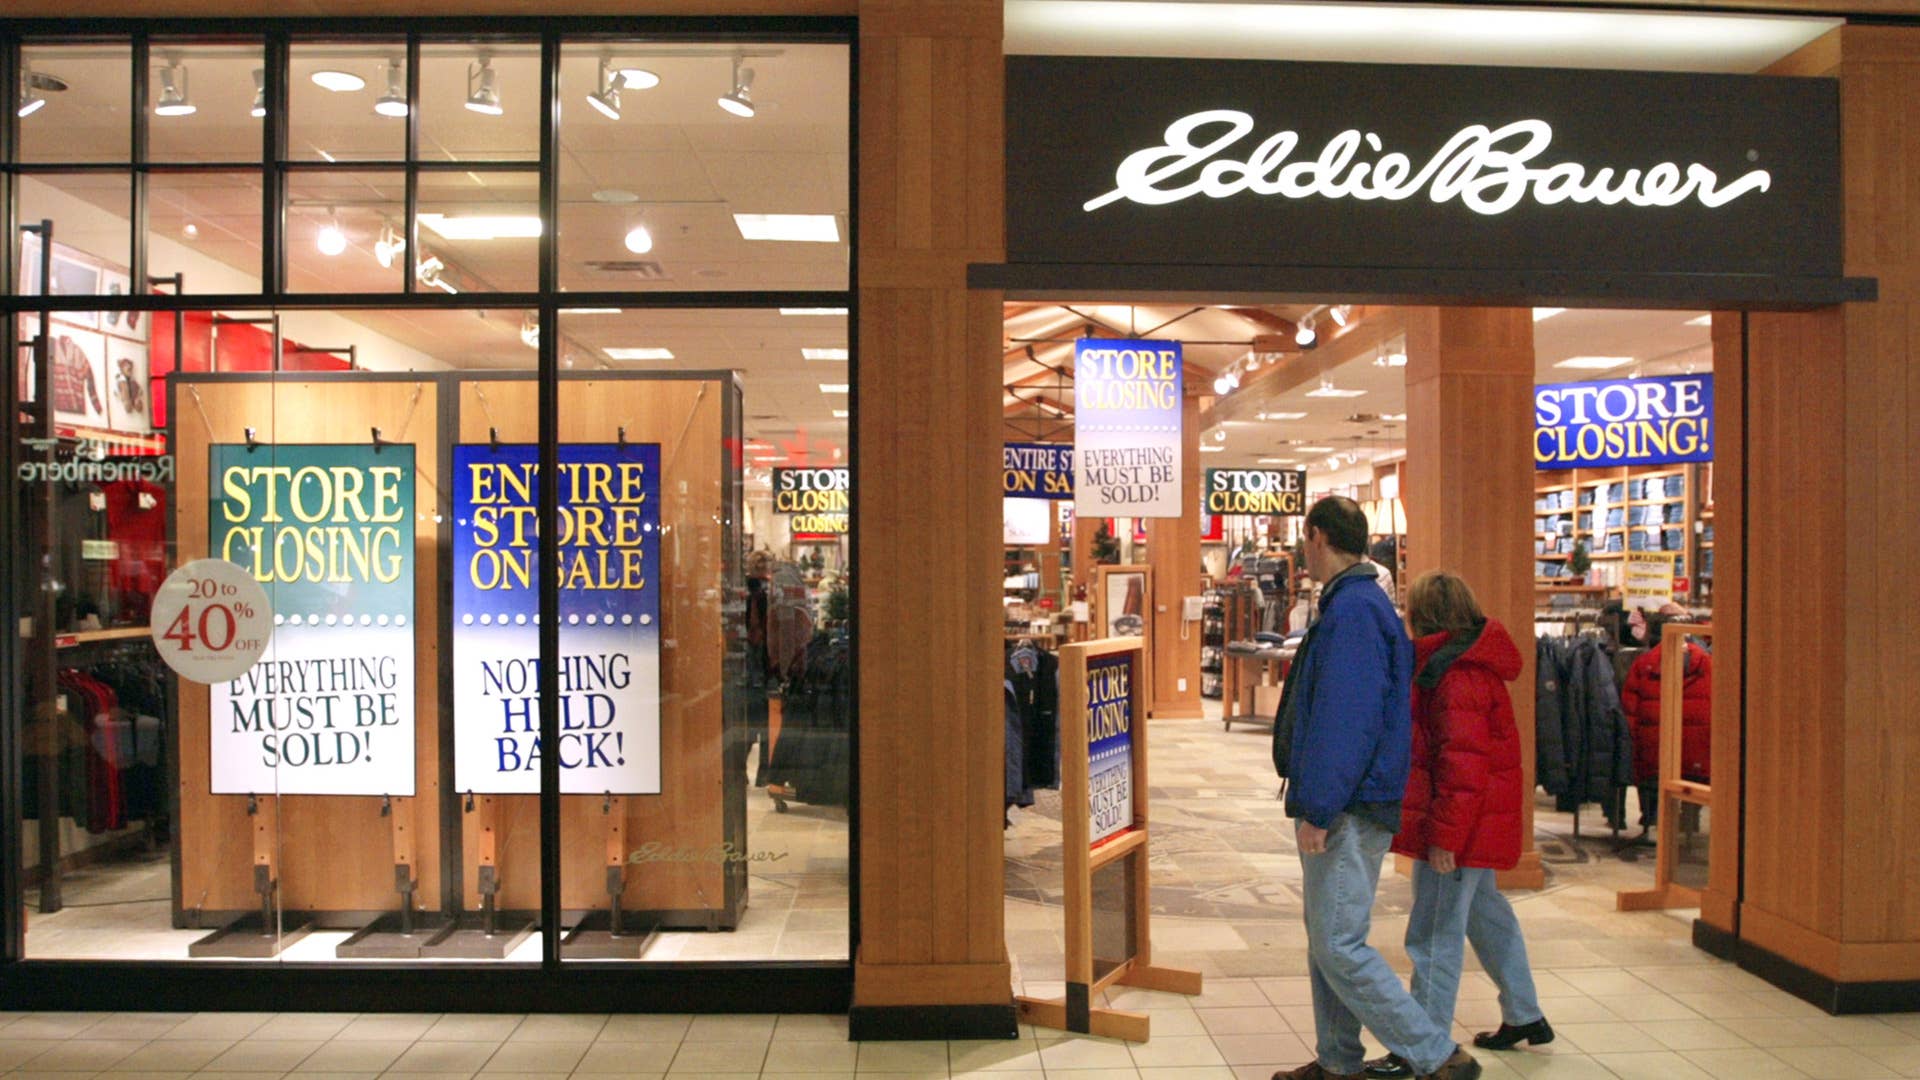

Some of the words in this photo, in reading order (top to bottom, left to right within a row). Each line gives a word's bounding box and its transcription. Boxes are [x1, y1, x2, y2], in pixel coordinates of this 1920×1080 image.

[1083, 109, 1414, 211] Eddie
[1428, 119, 1770, 214] Bauer
[1081, 348, 1176, 380] STORE
[1081, 380, 1176, 410] CLOSING
[1535, 380, 1705, 426] STORE
[1534, 417, 1710, 462] CLOSING!
[1003, 447, 1057, 470] ENTIRE
[1084, 447, 1173, 467] EVERYTHING
[1002, 469, 1037, 492] ON
[1044, 471, 1074, 493] SA
[1085, 467, 1142, 487] MUST
[1150, 465, 1174, 484] BE
[1212, 470, 1300, 492] STORE
[222, 466, 404, 523] STORE
[1100, 484, 1159, 504] SOLD!
[1209, 491, 1301, 512] CLOSING!
[222, 526, 404, 584] CLOSING
[470, 549, 532, 590] ON
[558, 549, 645, 590] ALE
[187, 578, 218, 599] 20
[221, 584, 238, 596] to
[235, 640, 261, 651] OFF
[230, 695, 341, 733] MUST
[353, 693, 400, 727] BE
[501, 693, 616, 733] HLD
[1088, 699, 1130, 742] LOSING
[262, 731, 372, 768] SOLD!
